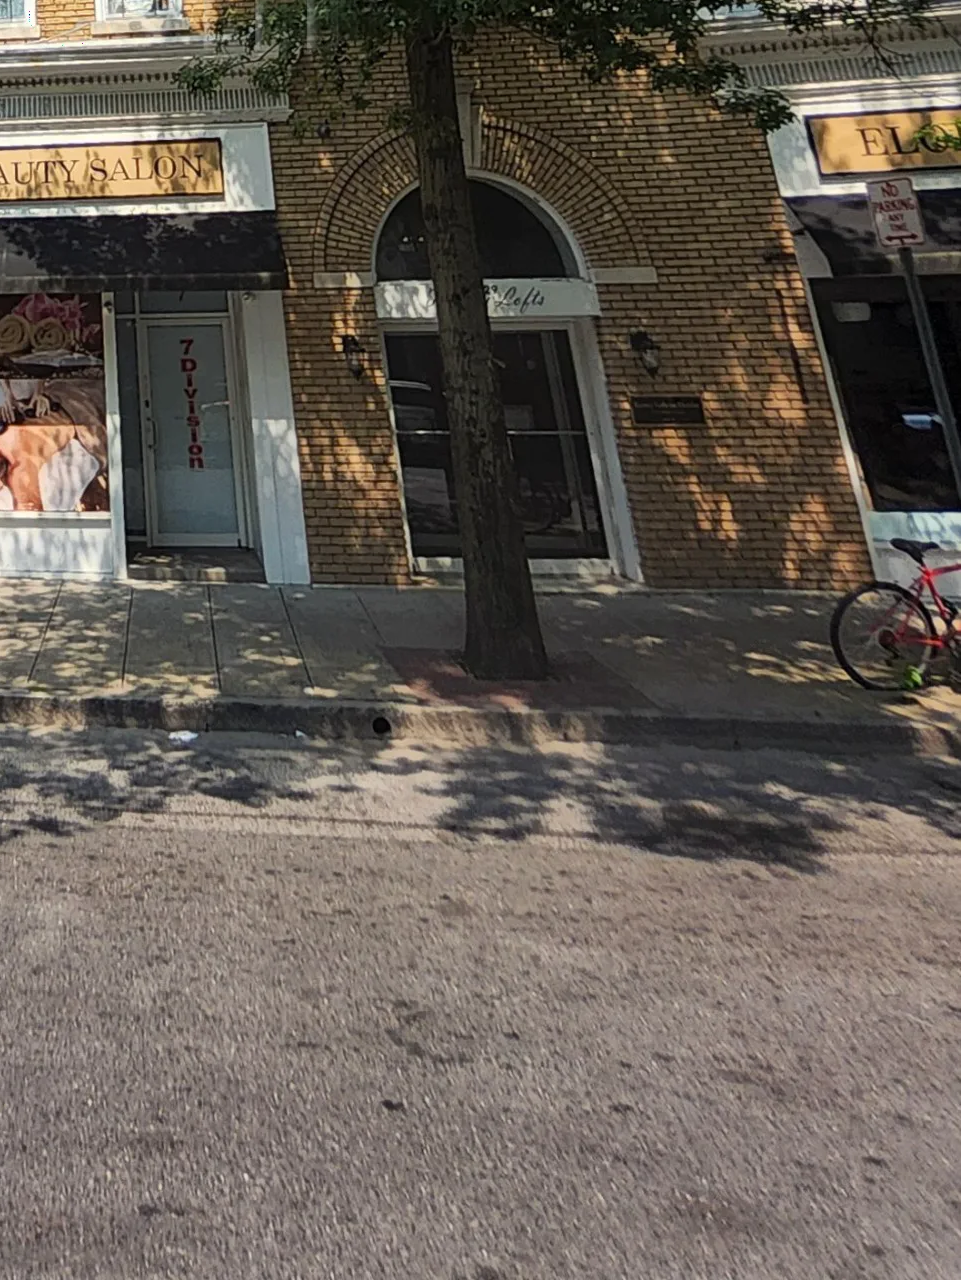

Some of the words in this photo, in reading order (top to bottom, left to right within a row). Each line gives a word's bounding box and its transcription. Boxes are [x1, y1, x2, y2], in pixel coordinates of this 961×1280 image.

[89, 153, 205, 183] SALON
[880, 182, 899, 198] NO
[872, 198, 916, 214] PARKING
[180, 339, 194, 356] 7
